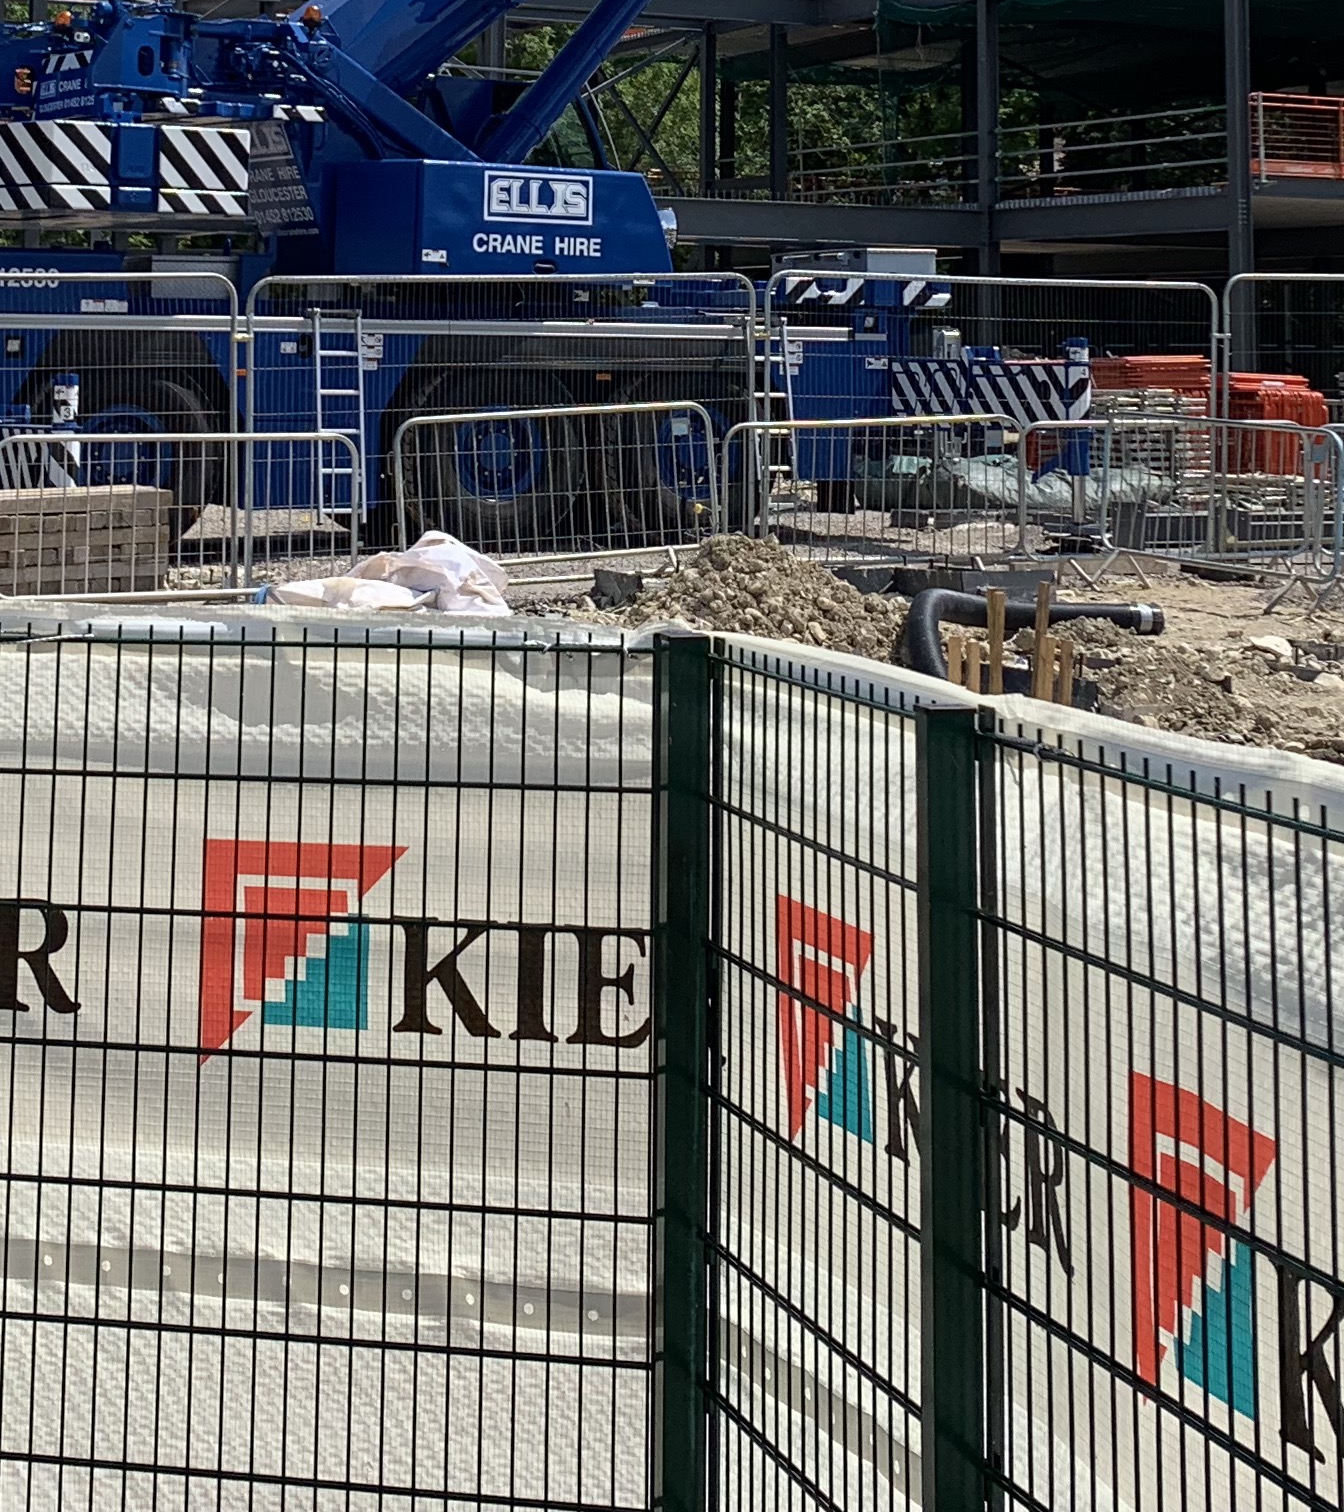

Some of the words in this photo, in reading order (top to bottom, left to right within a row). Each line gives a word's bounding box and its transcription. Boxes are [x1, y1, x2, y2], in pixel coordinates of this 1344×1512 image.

[58, 78, 82, 93] CRANE
[276, 165, 302, 181] HIRE
[248, 185, 309, 204] GLOUCESTER
[490, 177, 588, 217] ELLIS
[472, 233, 544, 255] CRANE
[555, 237, 602, 257] HIRE
[63, 407, 71, 419] 3
[391, 916, 653, 1048] KIE
